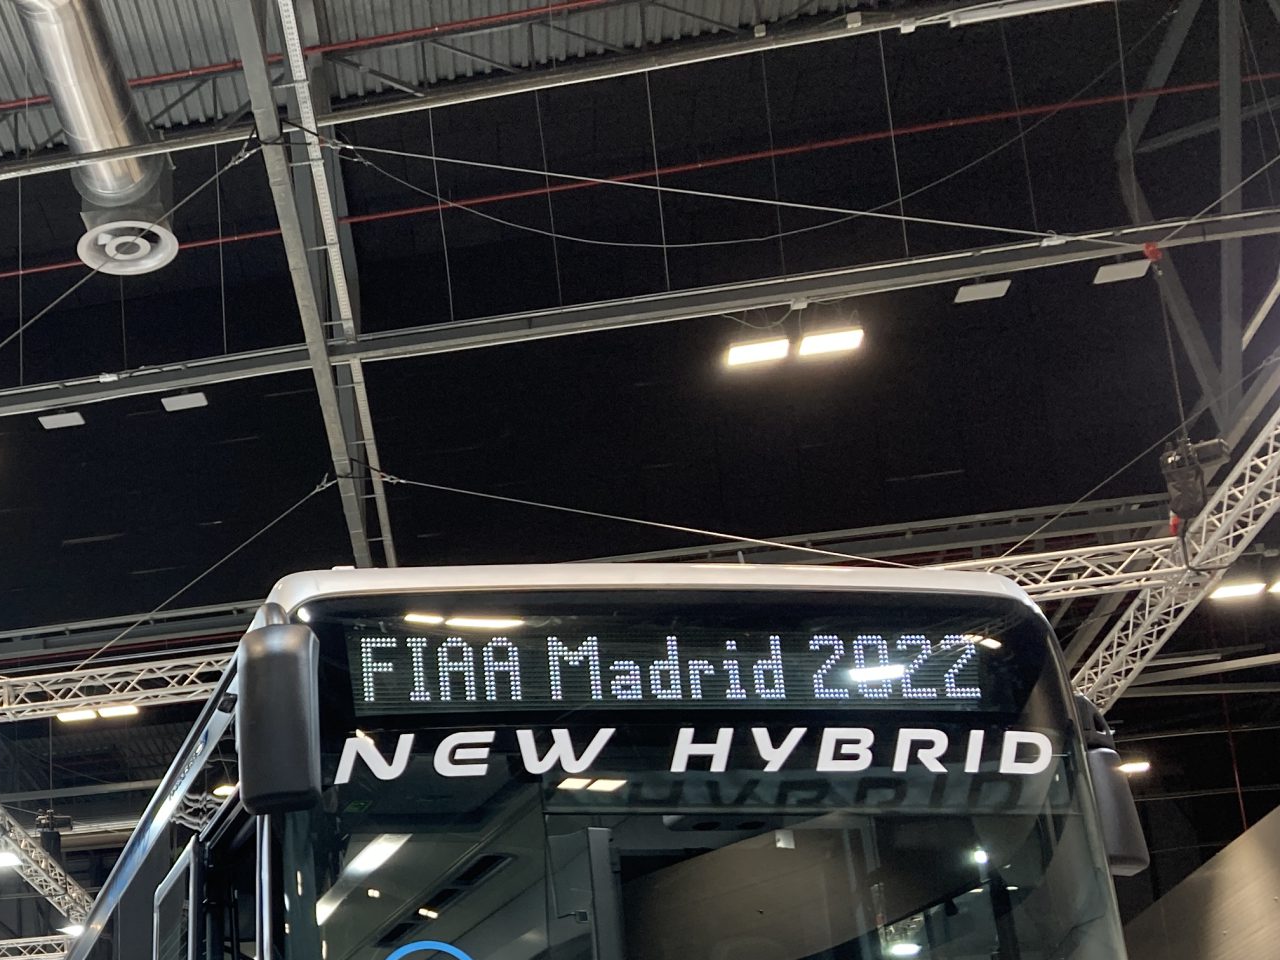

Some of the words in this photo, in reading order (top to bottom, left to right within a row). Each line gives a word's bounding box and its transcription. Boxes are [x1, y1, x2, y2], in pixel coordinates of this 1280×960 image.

[360, 636, 521, 701] FIAA
[548, 635, 785, 701] Madrid
[809, 634, 982, 698] 2022
[334, 728, 616, 785] NEW
[670, 727, 1054, 775] HYBRID
